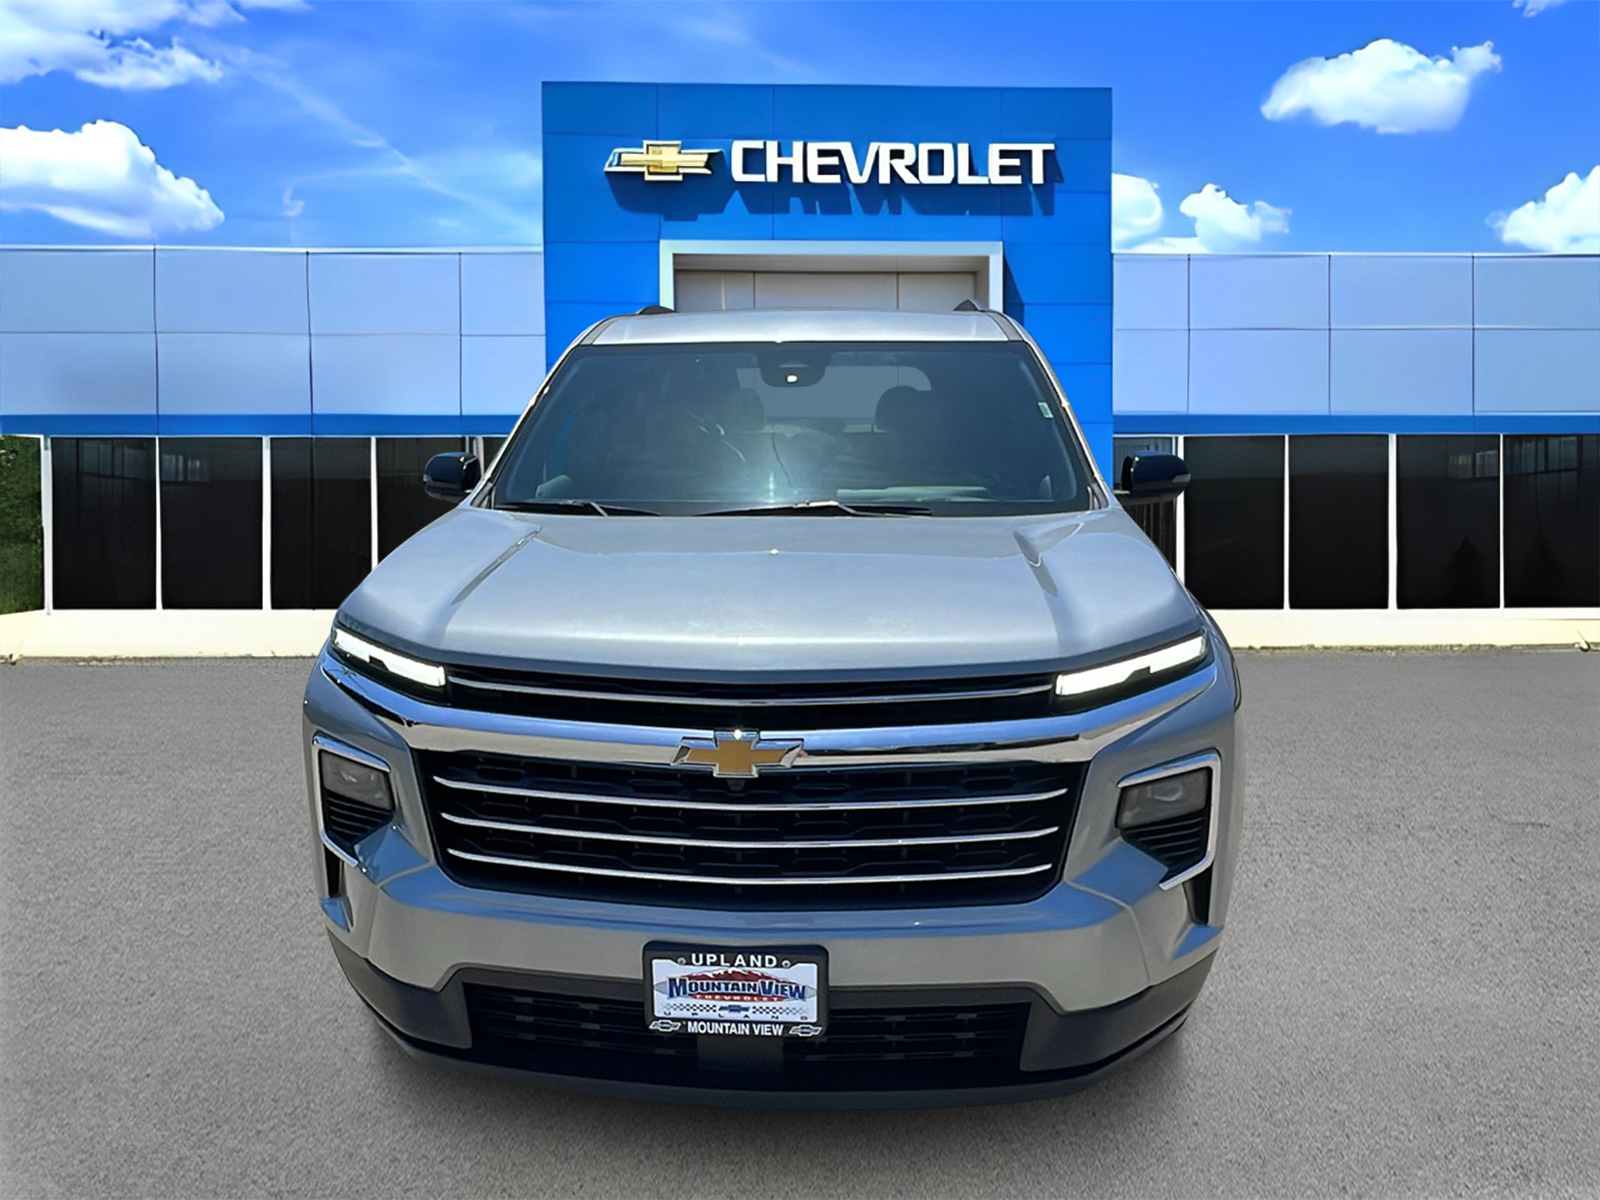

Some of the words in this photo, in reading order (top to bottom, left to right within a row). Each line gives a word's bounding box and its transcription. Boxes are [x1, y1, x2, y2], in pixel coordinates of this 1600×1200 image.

[731, 140, 1055, 185] CHEVROLET
[691, 953, 777, 968] UPLAND
[667, 977, 757, 998] MOUNTAIN
[758, 980, 806, 1000] VIEW
[687, 1021, 750, 1035] MOUNTAIN
[752, 1023, 783, 1036] VIEW
